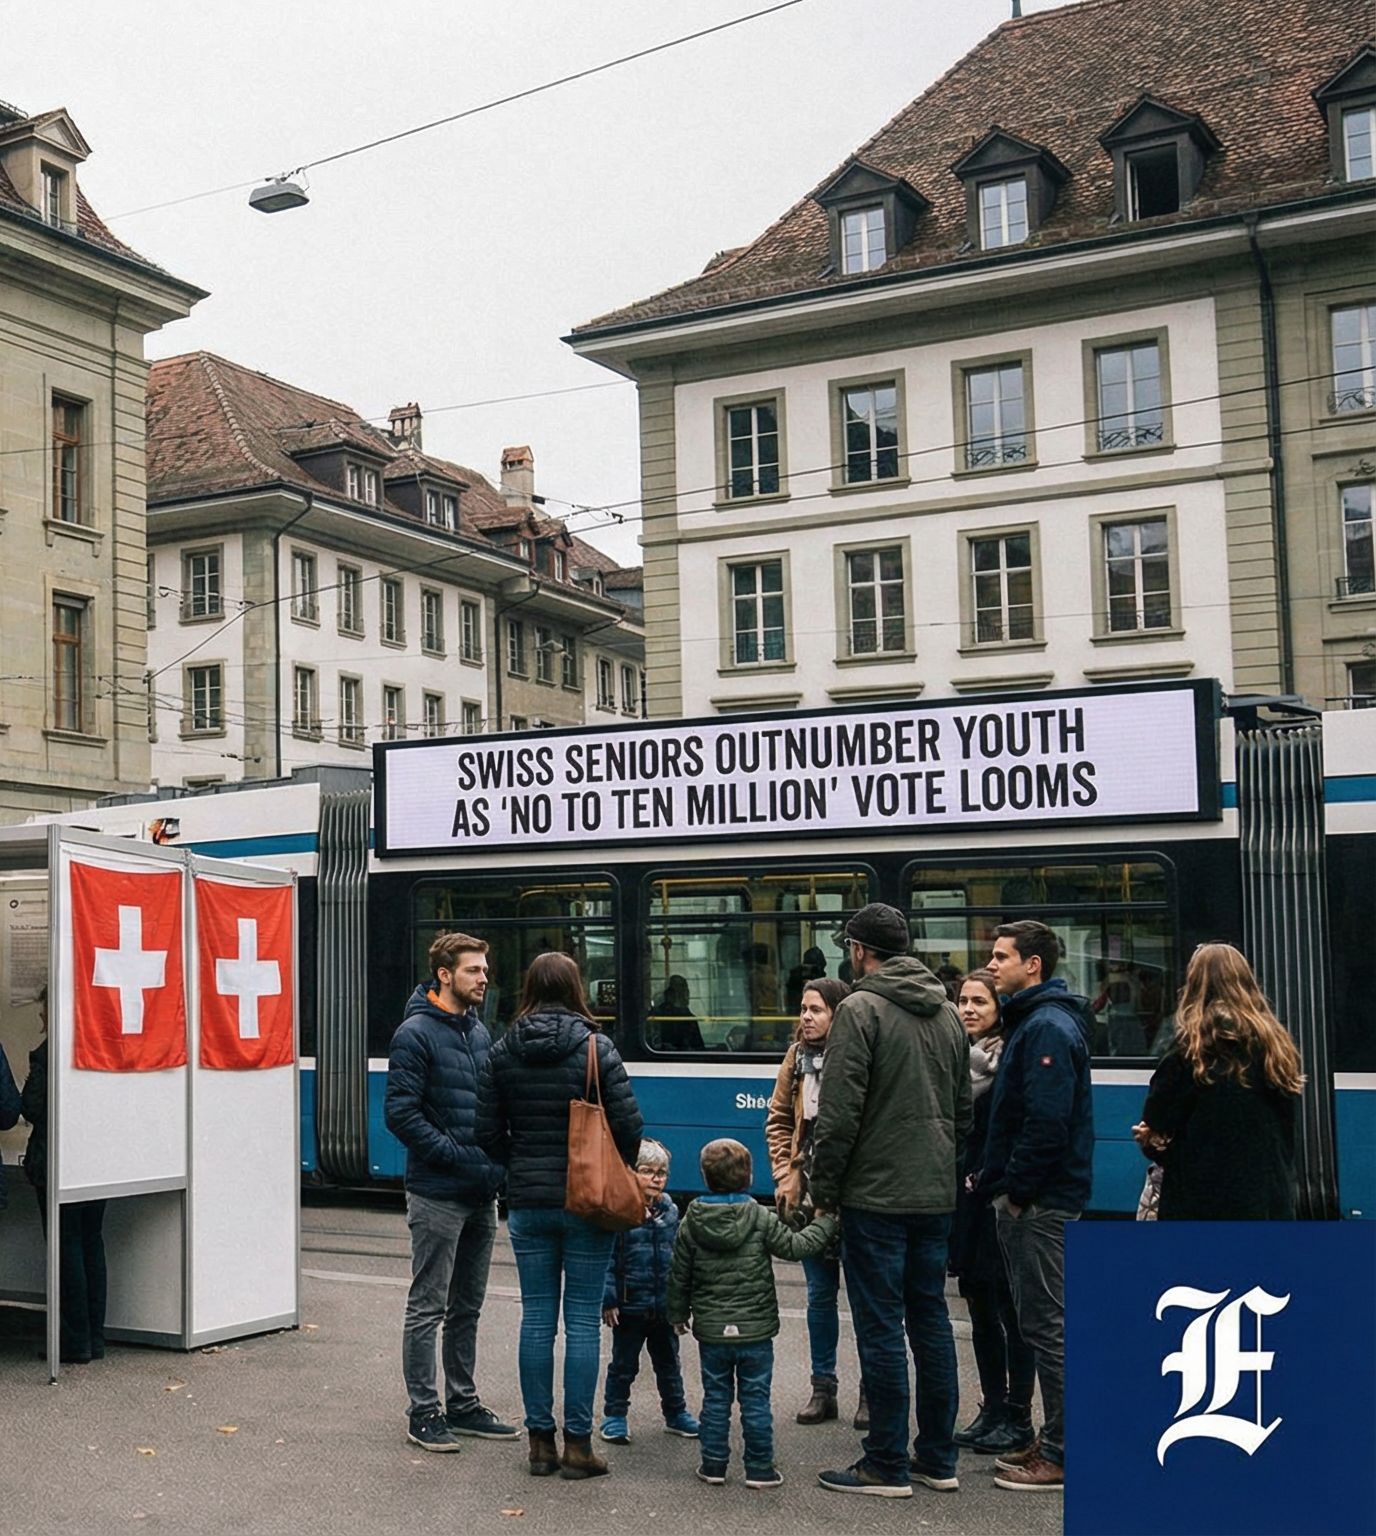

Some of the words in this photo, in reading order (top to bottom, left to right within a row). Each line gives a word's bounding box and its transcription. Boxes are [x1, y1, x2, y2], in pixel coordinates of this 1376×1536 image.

[458, 746, 554, 791] SWISS
[565, 735, 704, 785] SENIORS
[715, 718, 941, 775] OUTNUMBER
[952, 707, 1085, 760] YOUTH
[451, 797, 491, 838] AS
[561, 790, 601, 832] TO
[611, 786, 673, 830] TEN
[851, 770, 947, 818] VOTE
[960, 760, 1099, 813] LOOMS
